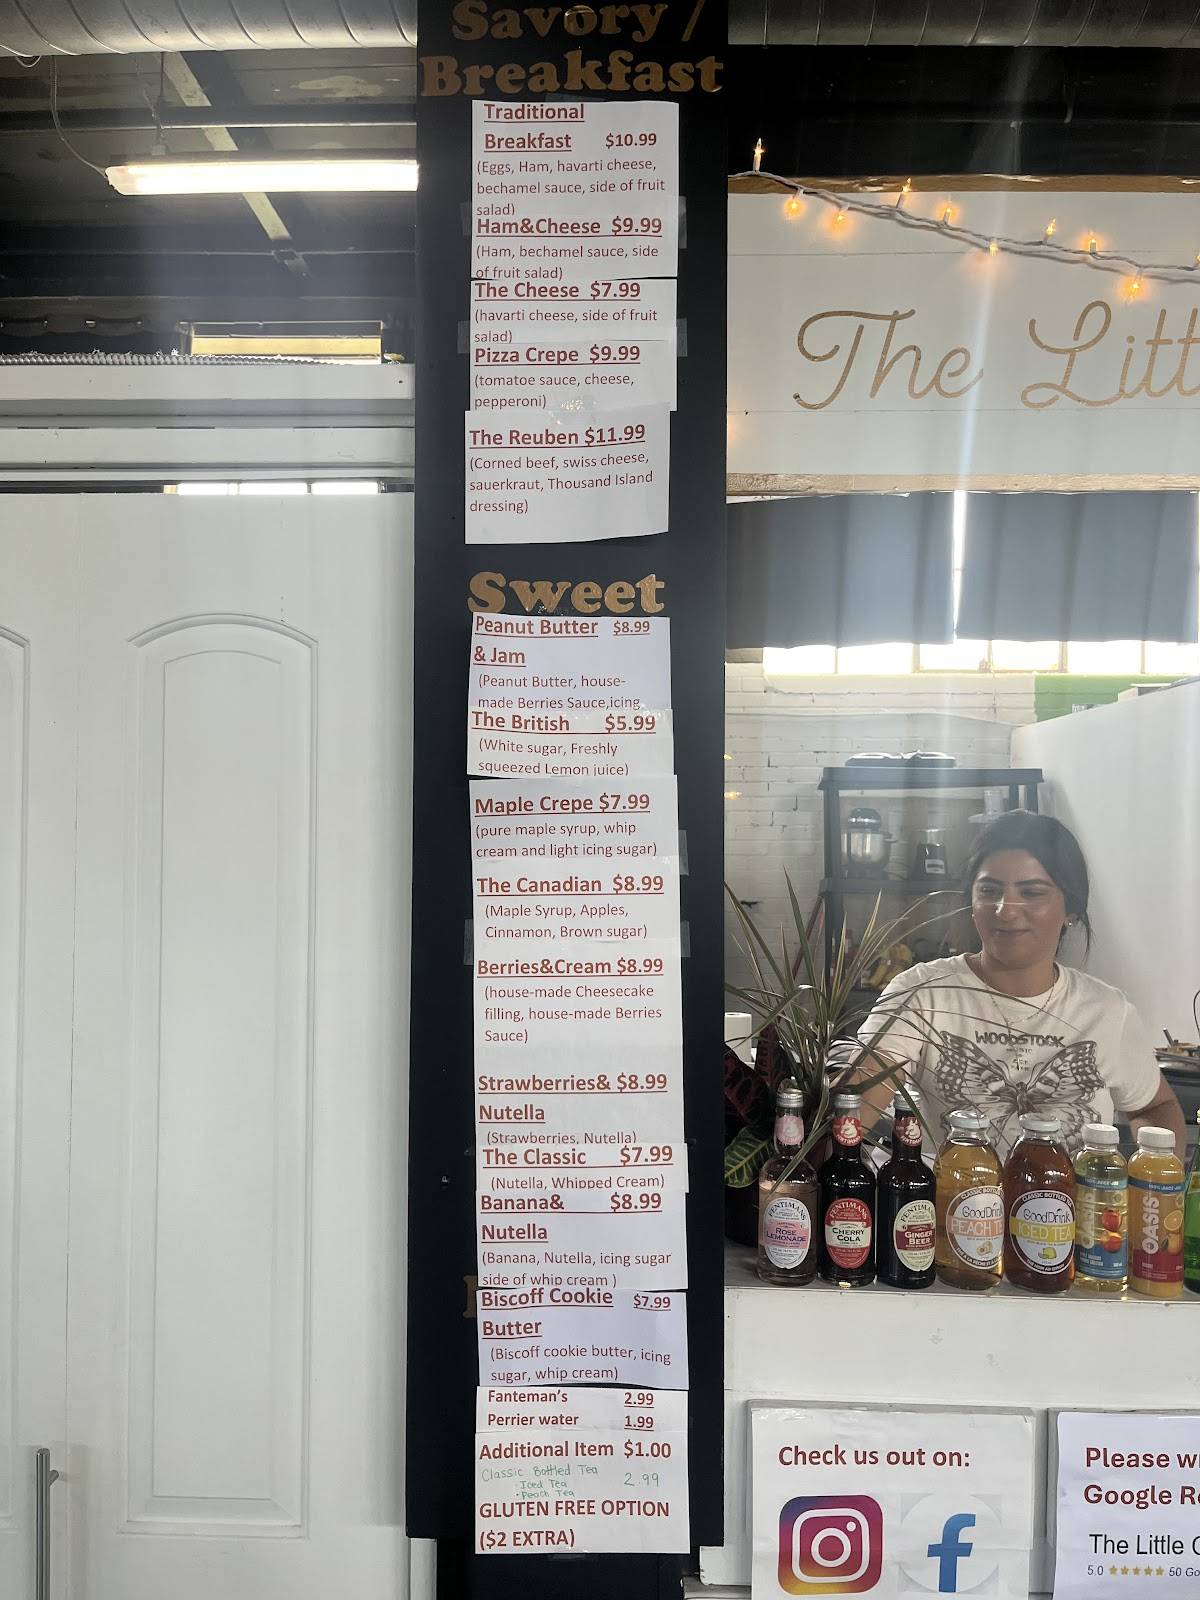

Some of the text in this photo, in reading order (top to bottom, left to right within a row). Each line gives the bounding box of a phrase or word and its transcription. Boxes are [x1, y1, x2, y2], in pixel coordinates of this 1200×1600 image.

[452, 3, 668, 42] Savory
[420, 50, 724, 96] Breakfast
[484, 103, 584, 120] Traditional
[484, 133, 657, 149] Breakfast $10.99
[476, 158, 656, 175] (Eggs, Ham, havarti cheese,
[476, 179, 665, 195] bechamel sauce, side of fruit
[476, 217, 662, 236] Ham&Cheese $9.99
[476, 245, 658, 259] (Ham, bechamel sauce, side
[475, 281, 641, 299] The Cheese $7.99
[475, 309, 657, 323] (havarti cheese, side of fruit
[475, 345, 640, 365] Pizza Crepe $9.99
[793, 309, 983, 409] The
[474, 374, 634, 387] (tomatoe sauce, cheese,
[470, 424, 645, 447] The Reuben $11.99
[470, 453, 649, 471] (Corned beef, swiss cheese,
[470, 471, 653, 492] sauerkraut, Thousand Island
[467, 571, 665, 614] Sweet
[476, 616, 650, 635] Peanut Butter $8.99
[474, 646, 525, 664] & Jam
[479, 674, 626, 689] (Peanut Butter, house-
[471, 711, 656, 733] The British $5.99
[479, 739, 618, 757] (White sugar, Freshly
[475, 794, 650, 815] Maple Crepe $7.99
[476, 821, 636, 839] (pure maple syrup, whip
[476, 842, 657, 858] cream and light icing sugar)
[477, 874, 664, 895] The Canadian $8.99
[485, 903, 629, 918] (Maple Syrup, Apples,
[485, 925, 647, 939] Cinnamon, Brown sugar)
[477, 957, 663, 976] Berries&Cream $8.99
[485, 985, 654, 1000] (house-made Cheesecake
[478, 1073, 668, 1093] Strawberries& $8.99
[479, 1104, 545, 1120] Nutella
[483, 1146, 673, 1166] The Classic $7.99
[481, 1193, 662, 1212] Banana& $8.99
[769, 1202, 806, 1220] FENTIMANS
[830, 1202, 867, 1220] FENTIMANS
[1024, 1209, 1070, 1223] GoodDrink
[482, 1224, 548, 1240] Nutella
[951, 1221, 990, 1235] PEACH
[1019, 1222, 1071, 1240] ICED TEA
[1142, 1197, 1160, 1254] OASIS
[482, 1252, 671, 1267] (Banana, Nutella, icing sugar
[482, 1289, 544, 1306] Biscoff
[550, 1288, 613, 1305] Cookie
[633, 1295, 671, 1309] $7.99
[482, 1320, 542, 1336] Butter
[491, 1344, 671, 1365] (Biscoff cookie butter, icing
[624, 1392, 654, 1405] 2.99
[488, 1414, 654, 1428] Perrier water 1.99
[479, 1440, 672, 1459] Additional Item $1.00
[778, 1446, 970, 1467] Check us out on:
[1086, 1447, 1169, 1468] Please
[481, 1465, 659, 1487] Classic Bottled Tea 2.99
[520, 1480, 567, 1489] Iced Tea
[1084, 1485, 1172, 1509] Google
[479, 1500, 669, 1518] GLUTEN FREE OPTION
[480, 1529, 575, 1550] ($2 EXTRA)
[1089, 1534, 1183, 1554] The Little
[1087, 1566, 1181, 1576] 5.0 50
